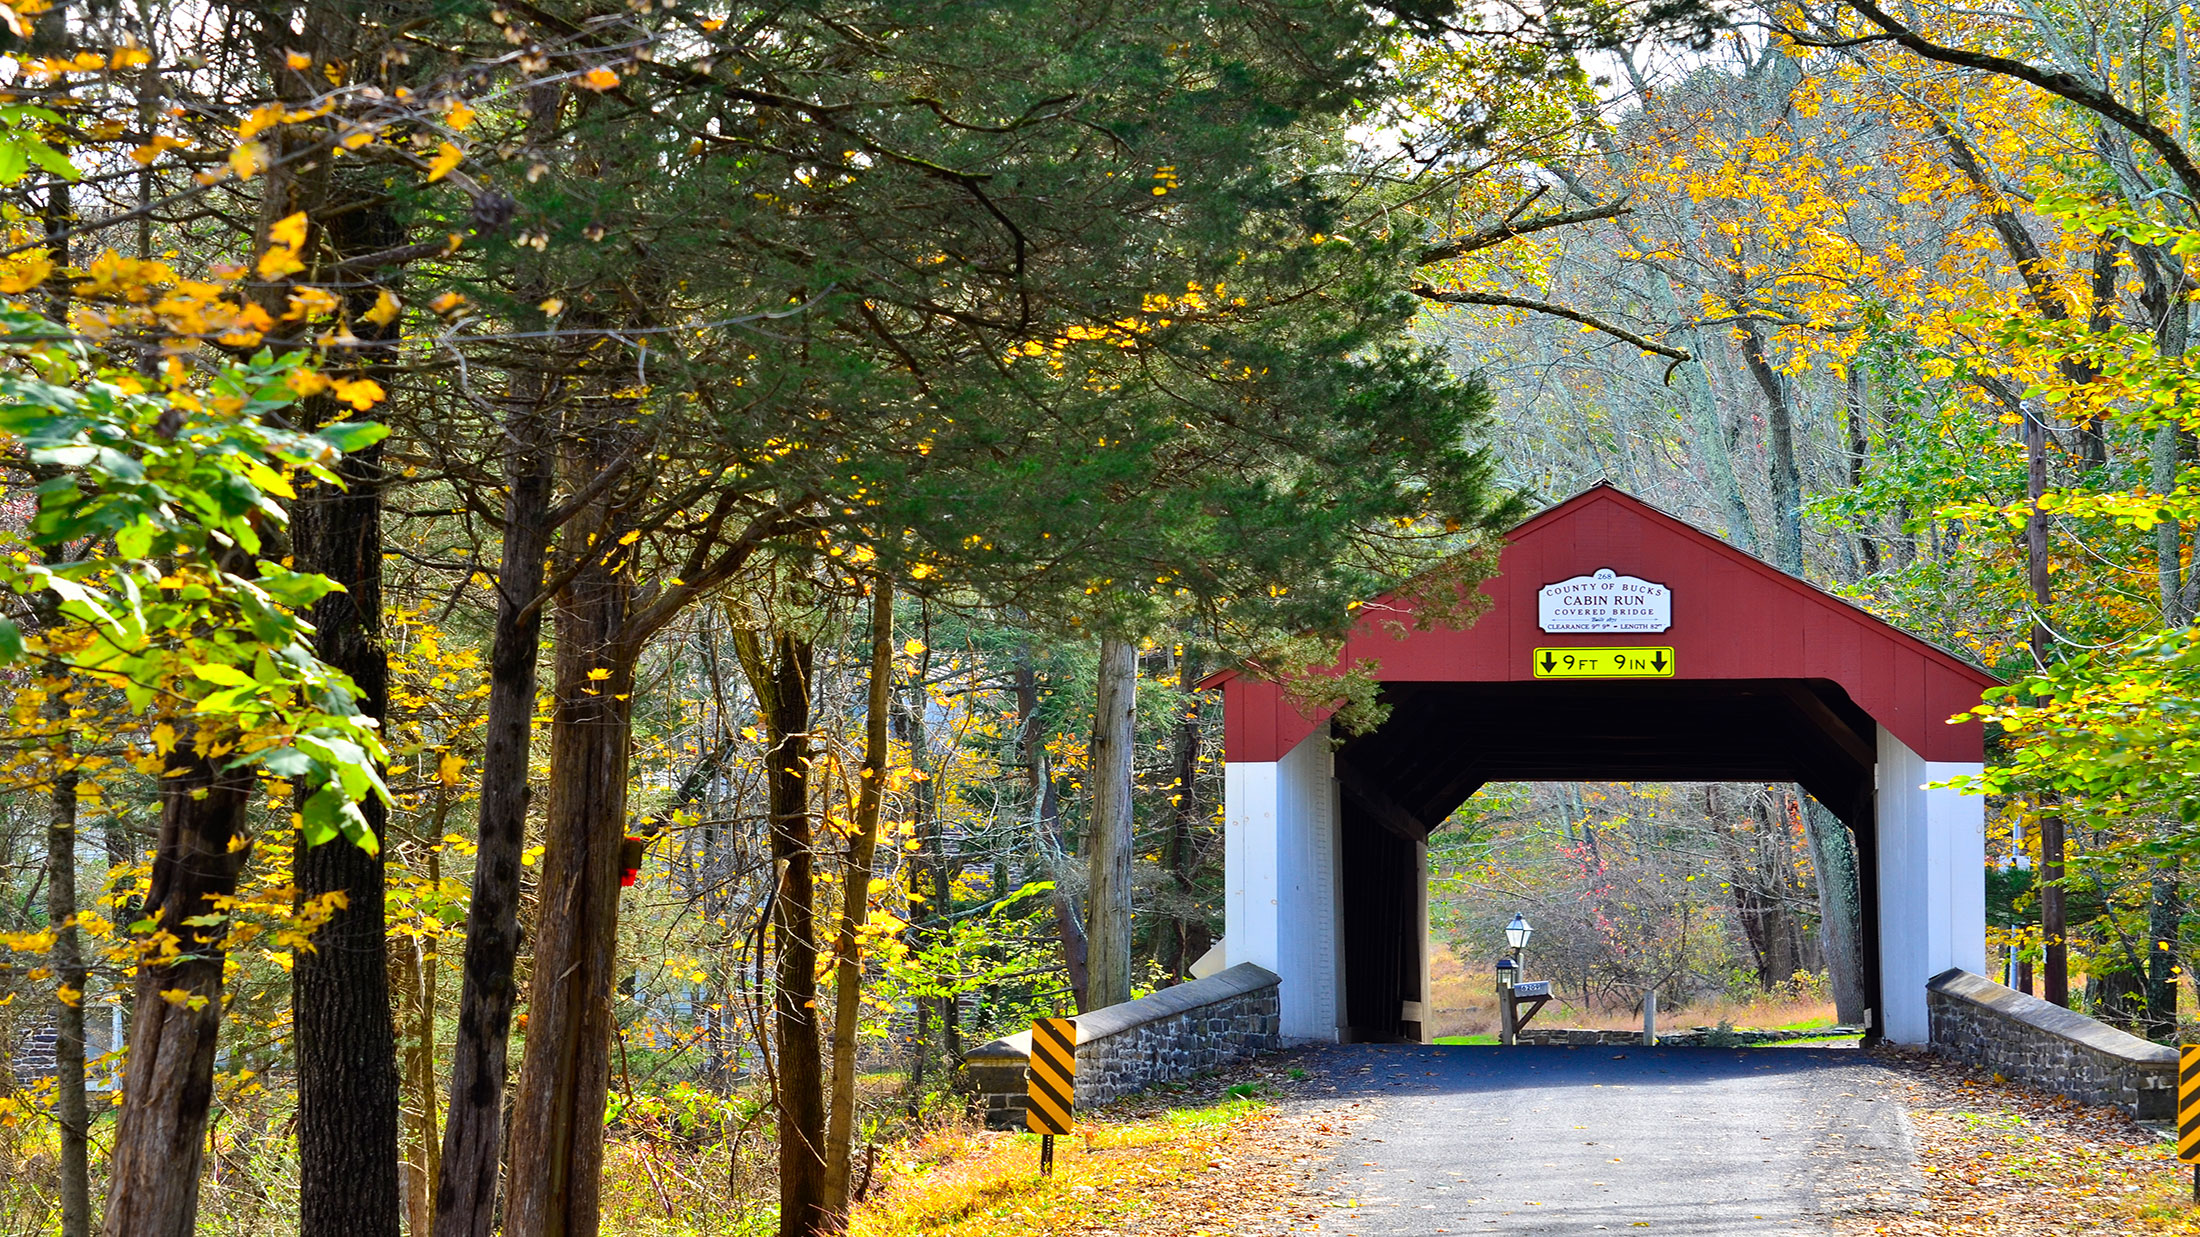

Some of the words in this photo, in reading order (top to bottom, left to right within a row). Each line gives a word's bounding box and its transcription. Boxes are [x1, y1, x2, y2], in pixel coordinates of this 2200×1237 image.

[1546, 583, 1596, 597] COUNTY
[1622, 584, 1662, 597] BUCKS
[1563, 595, 1608, 606] CABIN
[1614, 595, 1644, 606] RUN
[1612, 608, 1654, 616] BRIDGE
